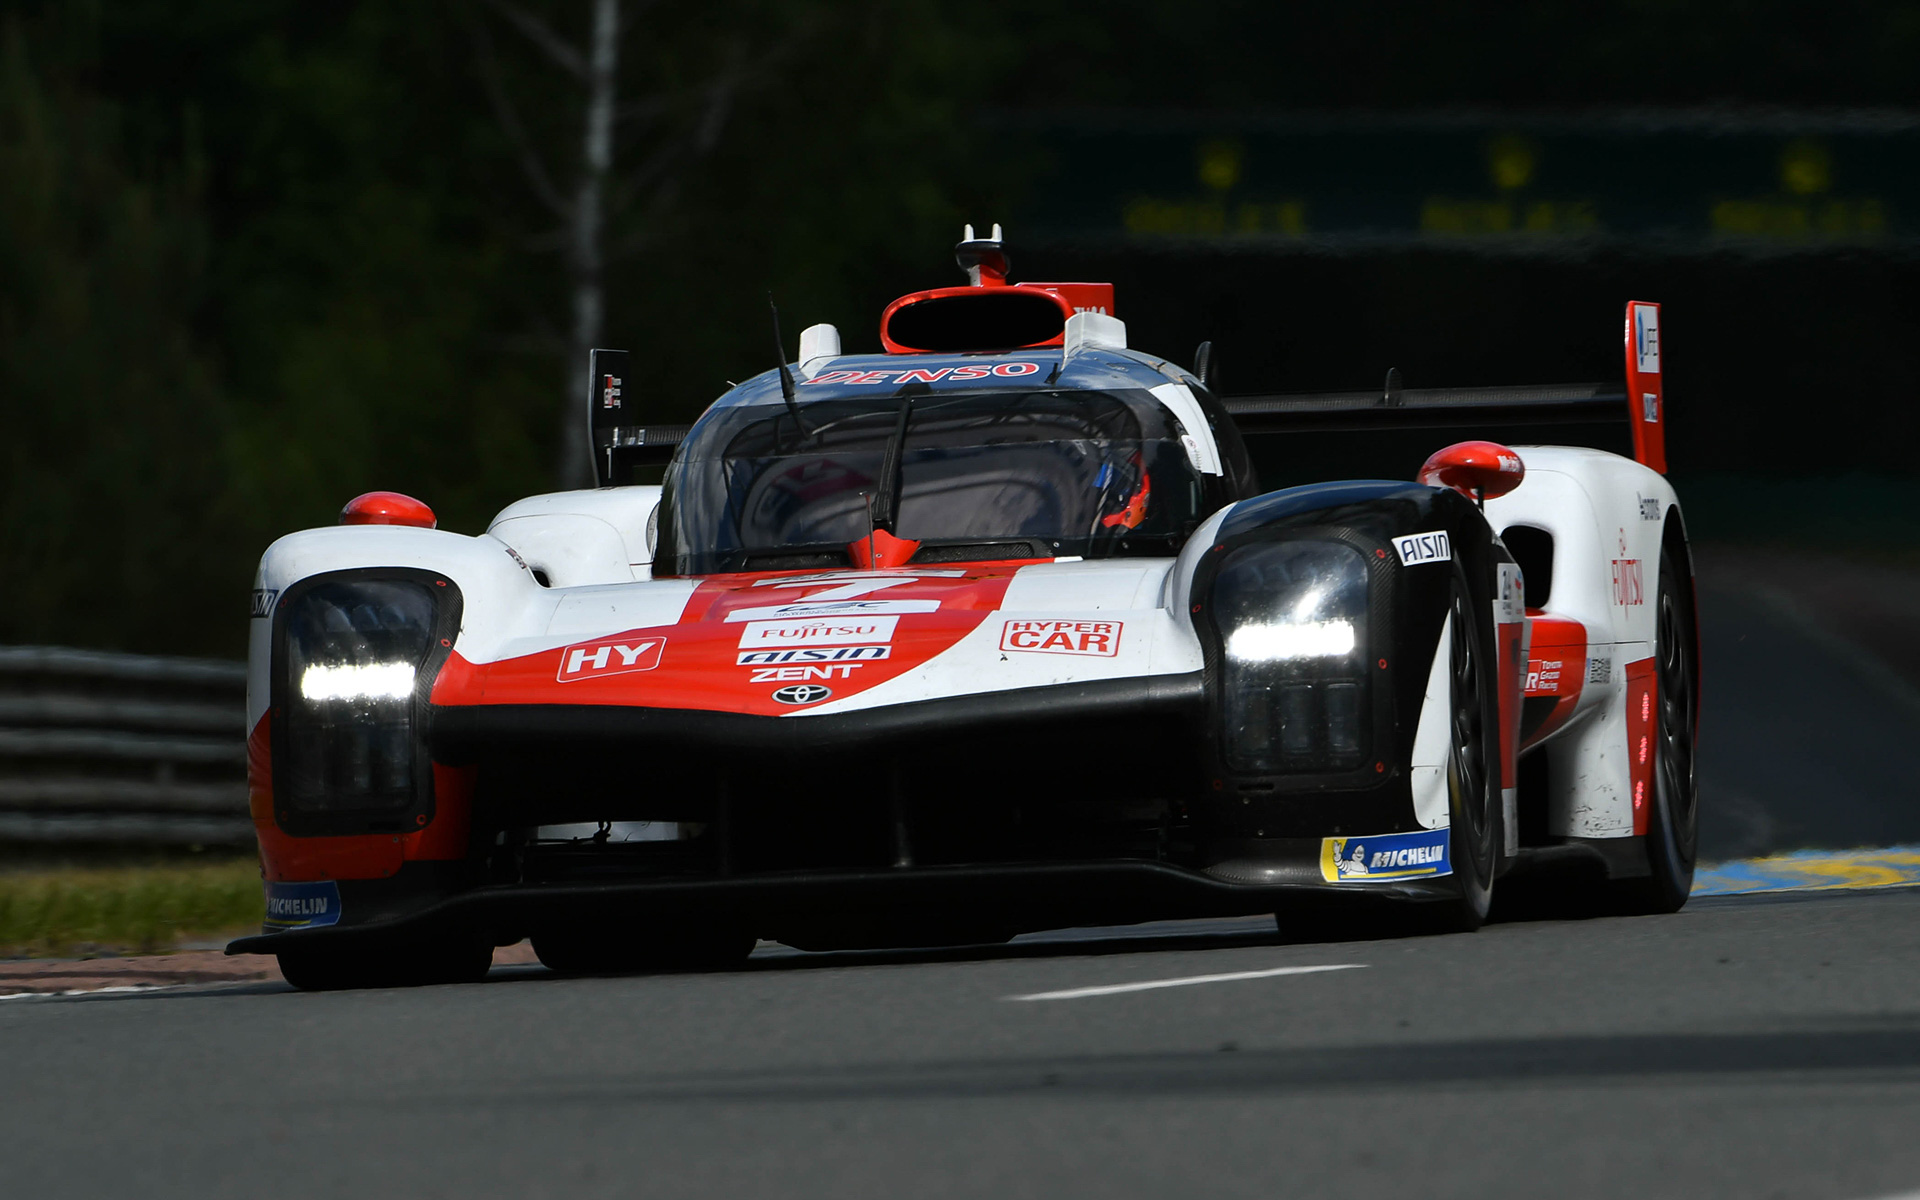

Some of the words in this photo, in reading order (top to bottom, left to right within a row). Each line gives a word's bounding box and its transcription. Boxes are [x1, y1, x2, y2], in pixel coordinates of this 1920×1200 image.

[801, 363, 1040, 385] DENSO
[1401, 534, 1449, 562] AISIN
[773, 577, 919, 602] 7
[761, 624, 876, 640] FUJITSU
[1012, 622, 1112, 634] HYPER
[1010, 631, 1109, 652] CAR
[566, 642, 656, 673] HY
[740, 647, 886, 664] AISIN
[750, 663, 863, 683] ZENT
[1369, 845, 1444, 868] MICHELIN
[269, 897, 328, 915] MICHELIN
